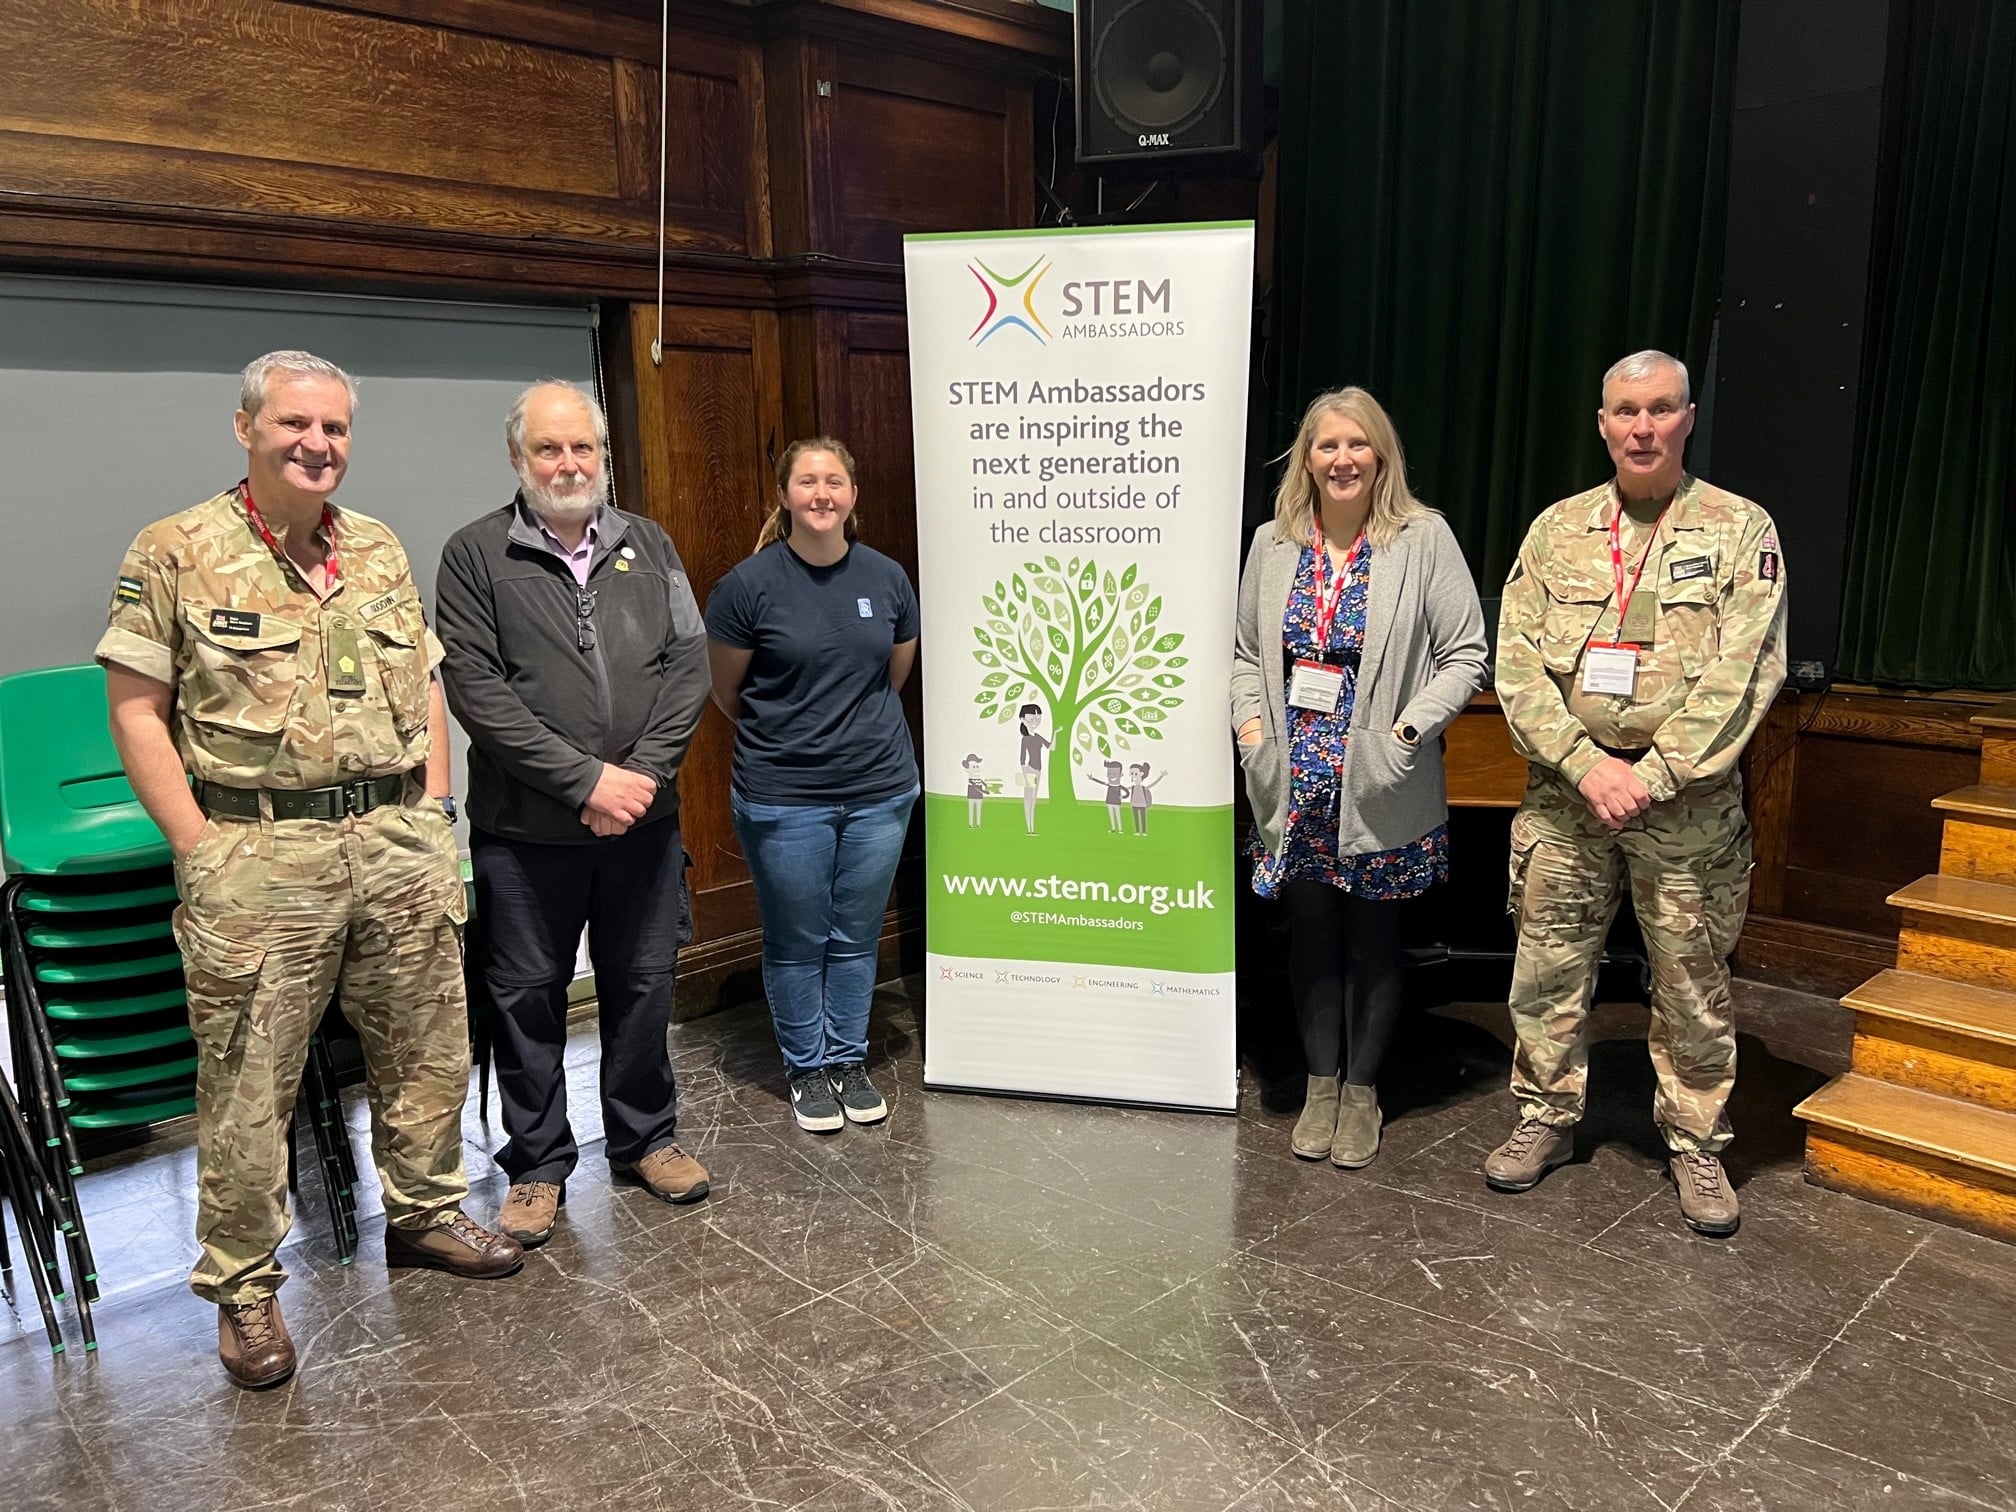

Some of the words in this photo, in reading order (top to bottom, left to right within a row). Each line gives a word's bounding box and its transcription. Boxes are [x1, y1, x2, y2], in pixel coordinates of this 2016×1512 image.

[1138, 134, 1169, 147] Q-MAX
[1062, 279, 1171, 317] STEM
[1062, 322, 1185, 339] AMBASSADORS
[949, 381, 1018, 406] STEM
[1027, 377, 1206, 404] Ambassadors
[969, 423, 1010, 440] are
[1019, 415, 1130, 447] inspiring
[1137, 413, 1183, 439] the
[972, 454, 1031, 475] next
[1038, 450, 1180, 482] generation
[973, 486, 994, 509] in
[1003, 485, 1047, 509] and
[1056, 485, 1146, 509] outside
[1155, 485, 1181, 509] of
[989, 520, 1030, 543] the
[1038, 520, 1161, 544] classroom
[942, 874, 1215, 914] www.stem.org.uk
[1010, 911, 1144, 931] @STEMAmbassadors
[954, 971, 983, 979] SCIENCE
[1010, 974, 1061, 983] TECHNOLOGY
[1088, 979, 1139, 989] ENGINEERING
[1166, 986, 1220, 996] MATHEMATICS
